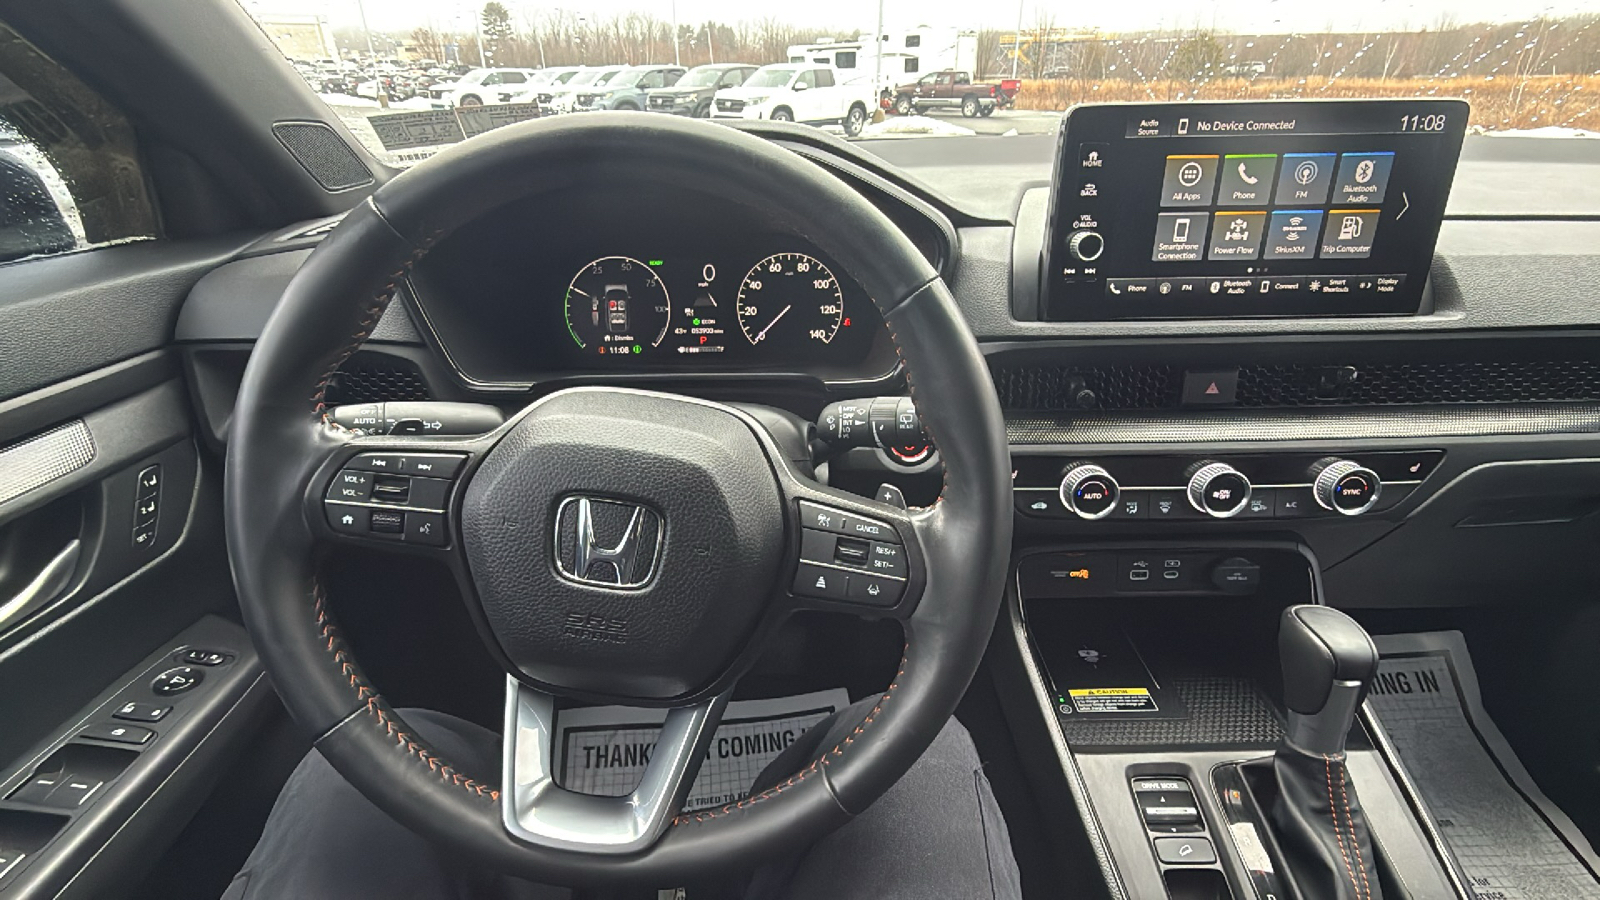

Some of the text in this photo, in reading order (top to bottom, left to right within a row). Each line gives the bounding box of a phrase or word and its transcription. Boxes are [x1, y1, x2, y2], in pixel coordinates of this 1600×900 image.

[1140, 119, 1159, 128] Audio
[1197, 119, 1296, 131] No Device Connected
[1400, 114, 1446, 132] 11:08
[1137, 128, 1159, 136] Source
[1342, 185, 1378, 193] Bluetooth
[1172, 192, 1201, 201] All Apps
[1232, 191, 1256, 200] Phone
[1295, 191, 1308, 199] FM
[1346, 194, 1369, 203] Audio
[1158, 243, 1199, 252] Smartphone
[1236, 246, 1254, 254] Flow
[1274, 246, 1306, 254] SiriusXM
[1322, 245, 1371, 254] Trip Computer
[1157, 252, 1197, 260] Connection
[592, 266, 603, 274] 25
[621, 263, 632, 271] 50
[769, 263, 782, 273] 60
[797, 263, 810, 273] 80
[702, 264, 716, 282] 0
[646, 280, 656, 288] 75
[749, 281, 762, 290] 40
[812, 280, 829, 289] 100
[1223, 280, 1252, 288] Bluetooth
[1329, 279, 1347, 287] Smart
[1376, 278, 1399, 286] Display
[1127, 285, 1148, 293] Phone
[744, 306, 758, 316] 20
[820, 305, 836, 314] 120
[809, 330, 826, 339] 140
[700, 336, 707, 345] P
[610, 346, 630, 355] 11:08
[353, 417, 376, 425] AUTO
[1342, 488, 1362, 496] SYNC
[856, 524, 880, 534] CANCEL
[1414, 669, 1440, 693] IN
[582, 743, 657, 769] THANK
